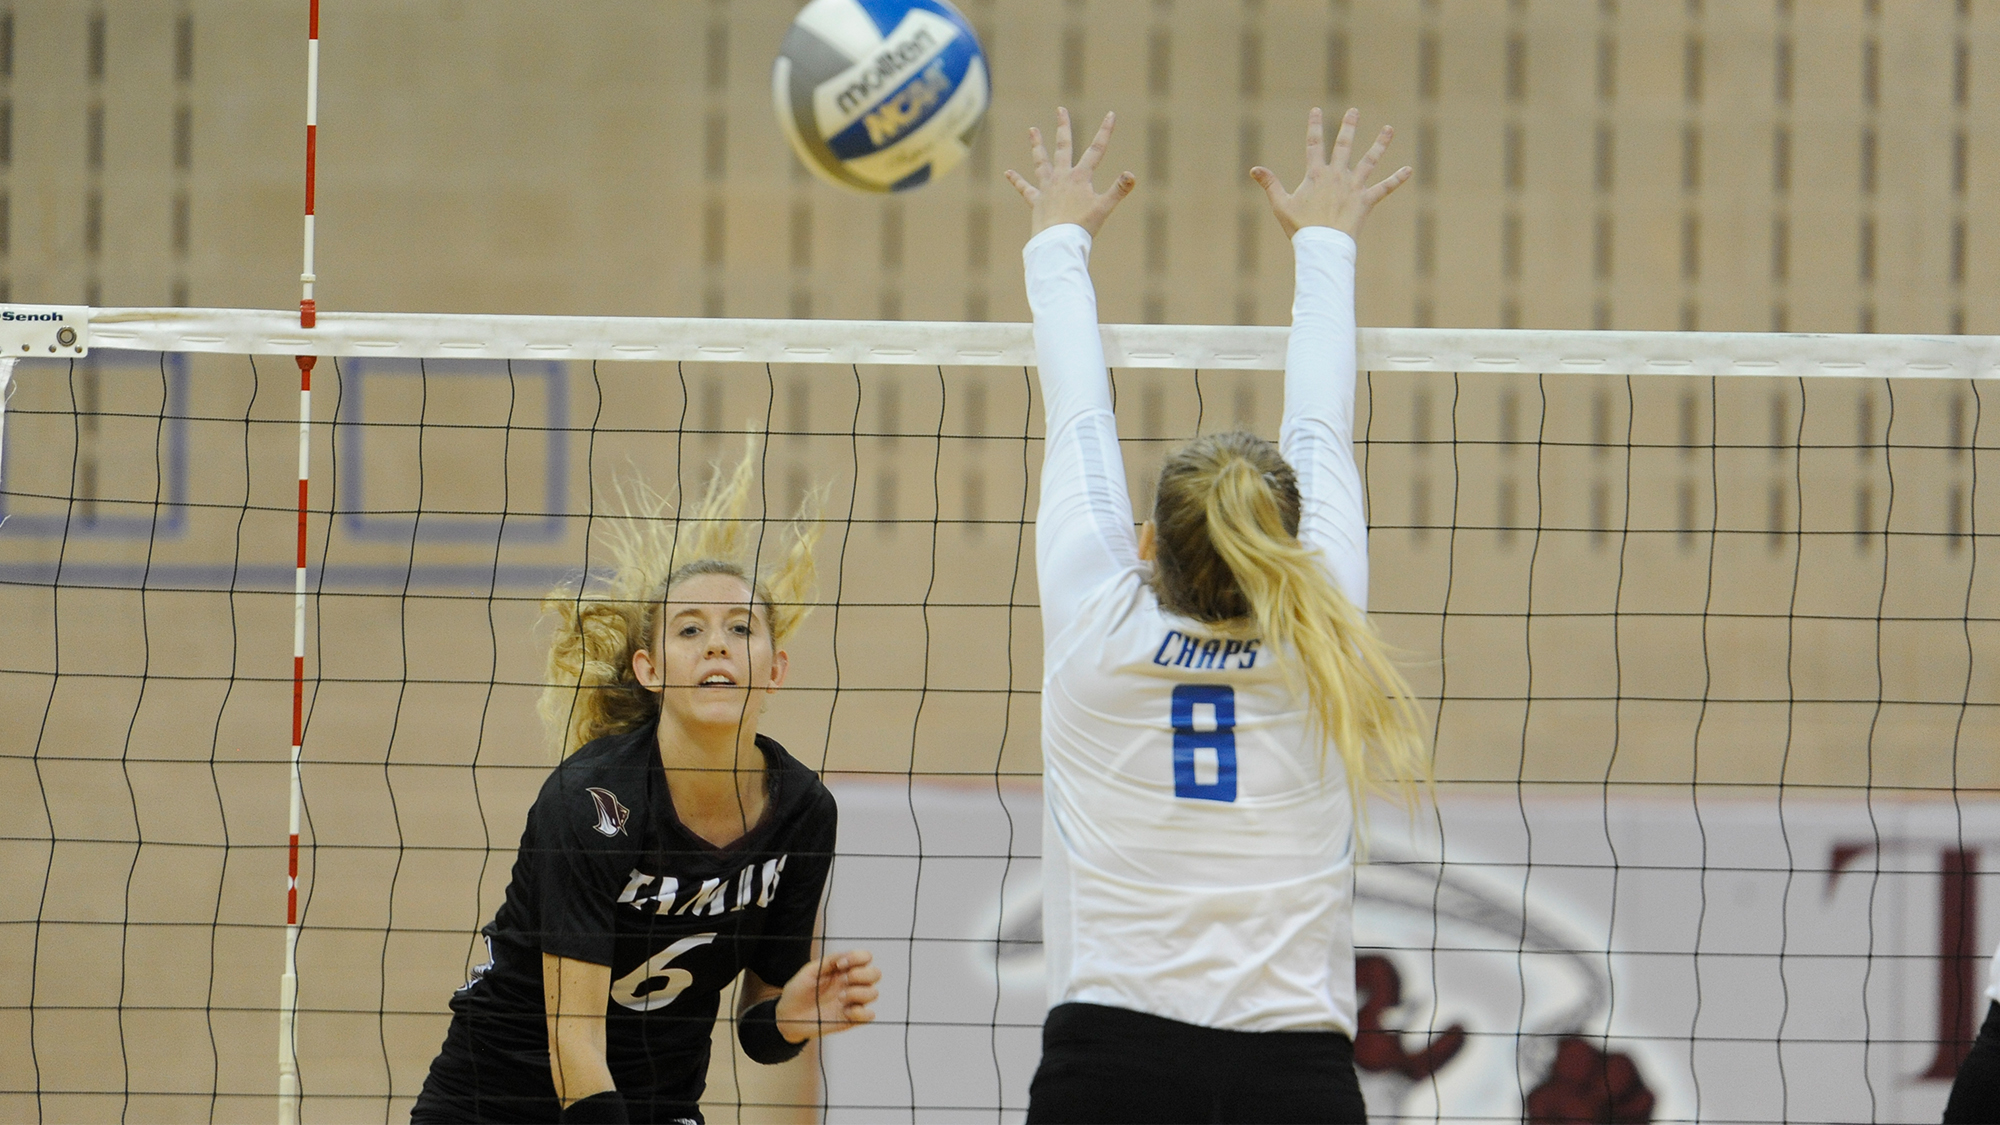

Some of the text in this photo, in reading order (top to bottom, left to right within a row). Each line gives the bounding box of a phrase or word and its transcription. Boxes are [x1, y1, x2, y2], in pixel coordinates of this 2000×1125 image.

[835, 24, 937, 117] molten
[2, 311, 64, 322] Senoh
[1153, 630, 1262, 670] CHAPS
[1170, 684, 1237, 803] 8
[610, 932, 718, 1012] 6
